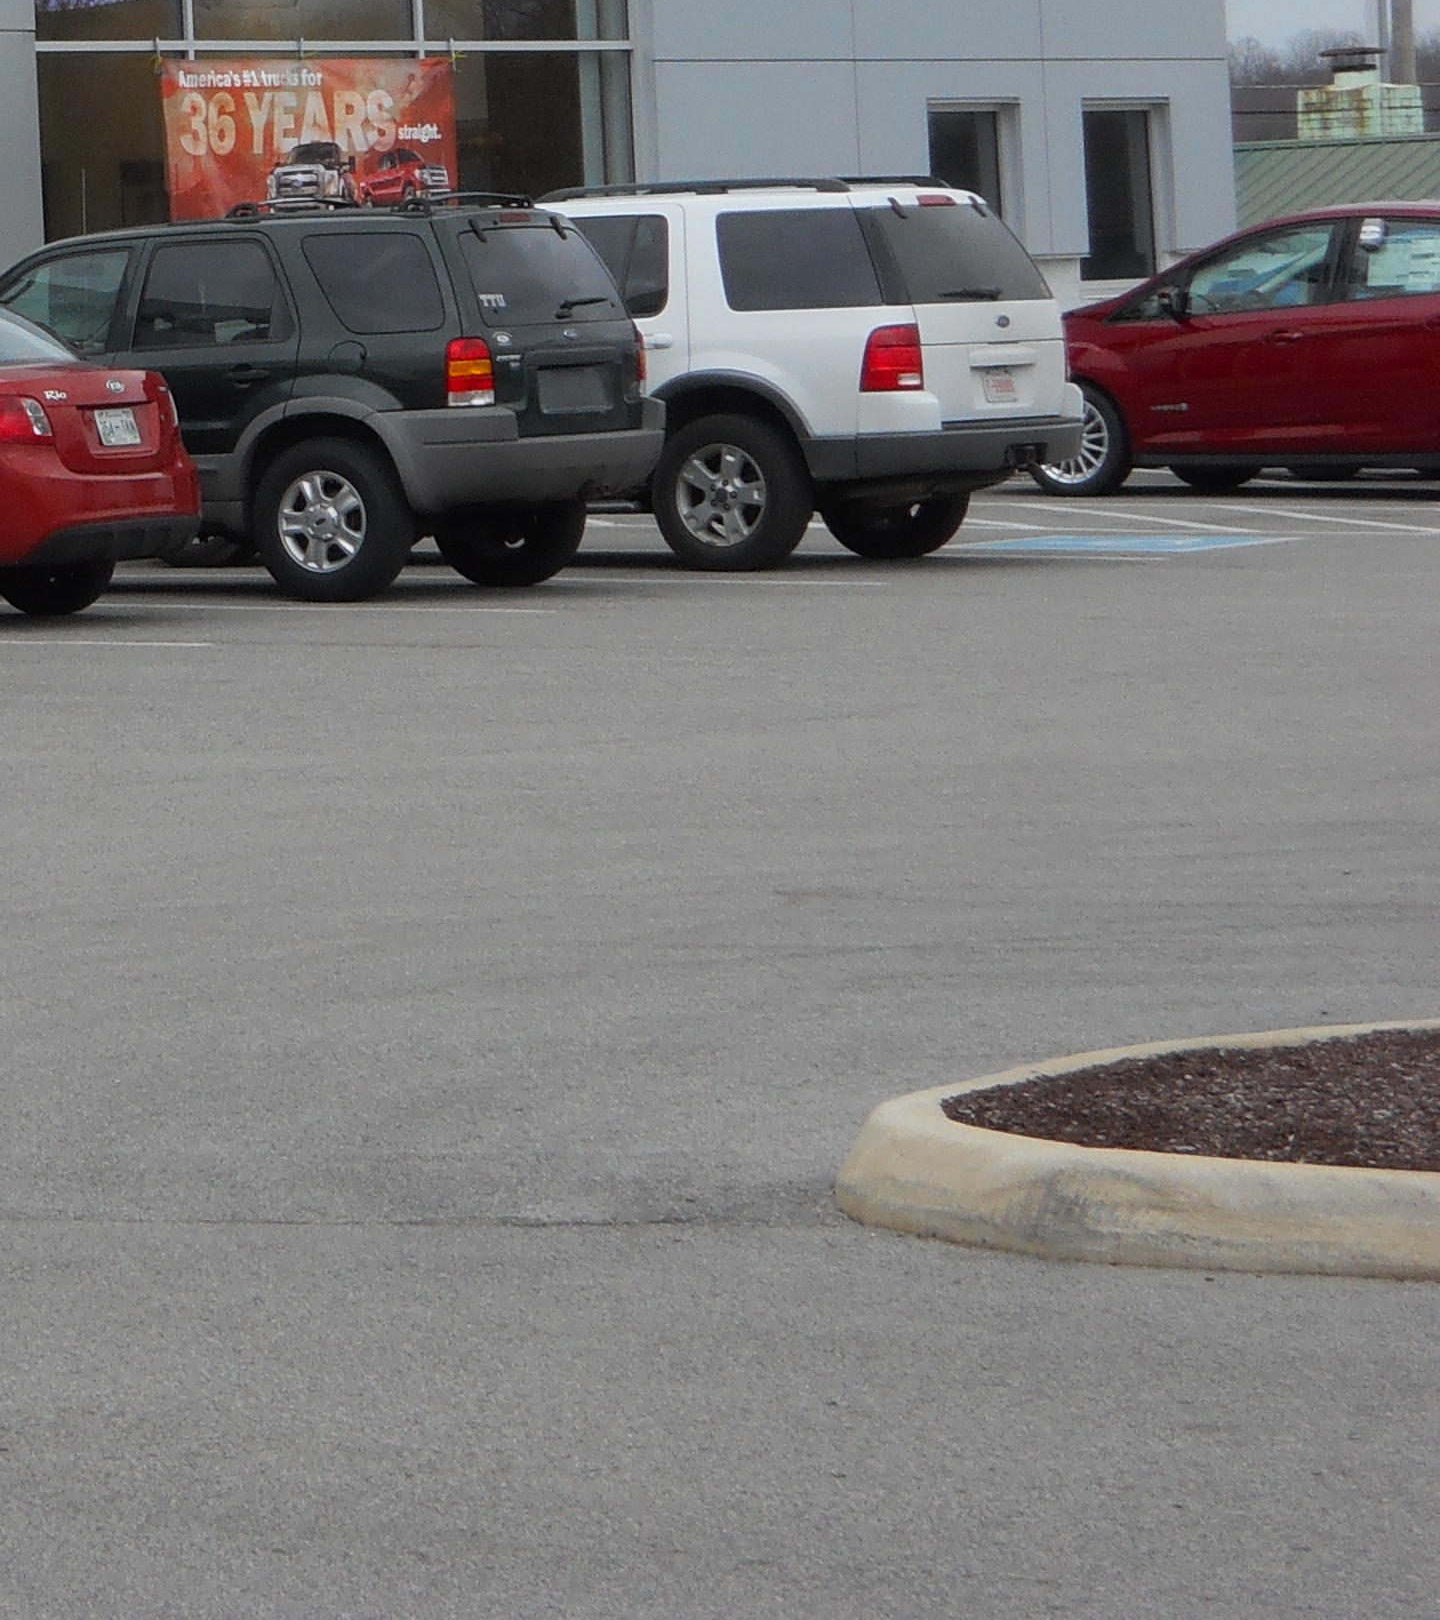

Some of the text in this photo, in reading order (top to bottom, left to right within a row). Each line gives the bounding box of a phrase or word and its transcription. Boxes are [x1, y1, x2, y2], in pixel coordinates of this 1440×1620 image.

[178, 70, 241, 88] America's
[259, 70, 300, 88] trucks
[301, 69, 323, 87] for
[179, 89, 398, 156] 36 YEARS
[397, 123, 443, 143] straight.
[43, 390, 68, 401] Rio
